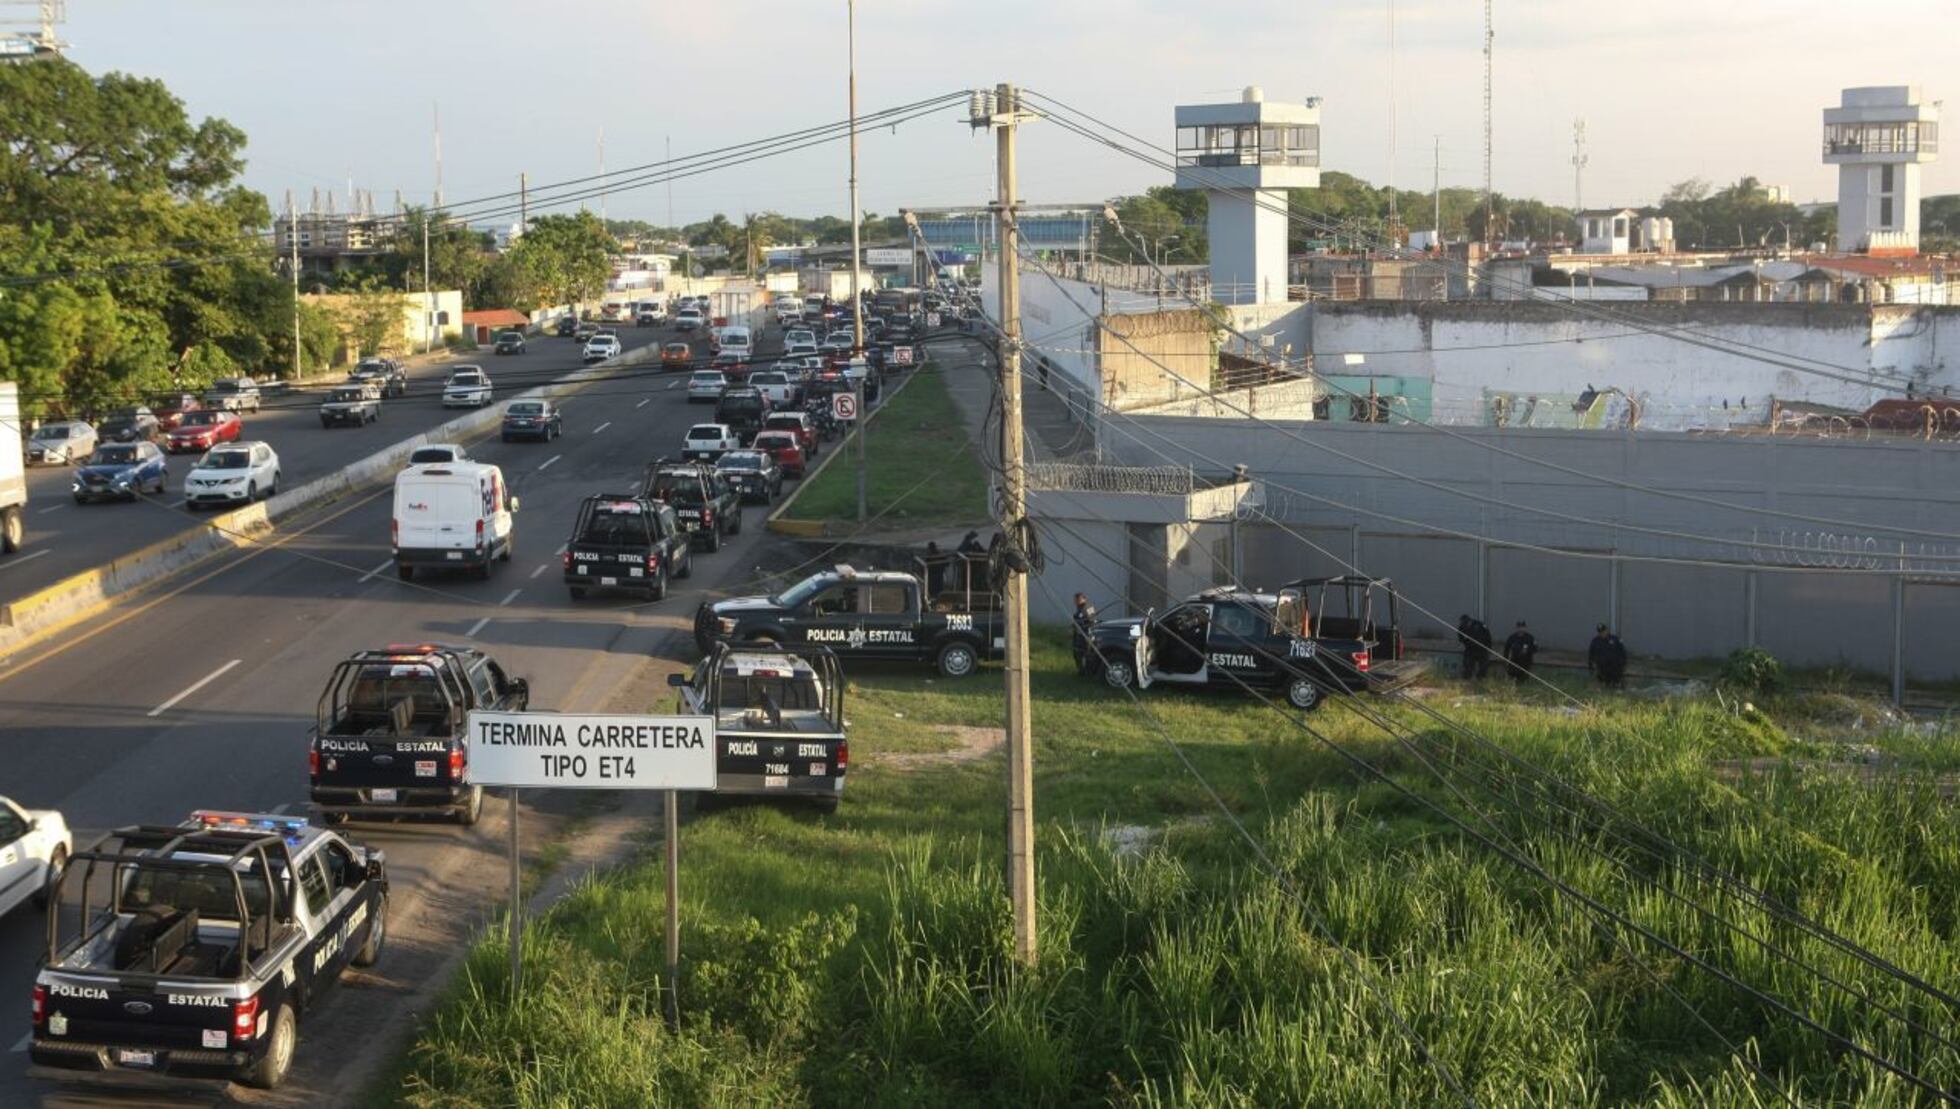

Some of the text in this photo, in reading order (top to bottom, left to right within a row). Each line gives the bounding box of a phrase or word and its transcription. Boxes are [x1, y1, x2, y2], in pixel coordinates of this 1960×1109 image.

[807, 629, 914, 642] POLICIA ESTATAL
[1212, 653, 1256, 668] ESTATAL
[479, 722, 704, 749] TERMINA CARRETERA
[396, 742, 446, 752] ESTATAL
[798, 743, 828, 757] ESTATAL
[541, 754, 636, 779] TIPO ET4
[168, 993, 229, 1008] ESTATAL
